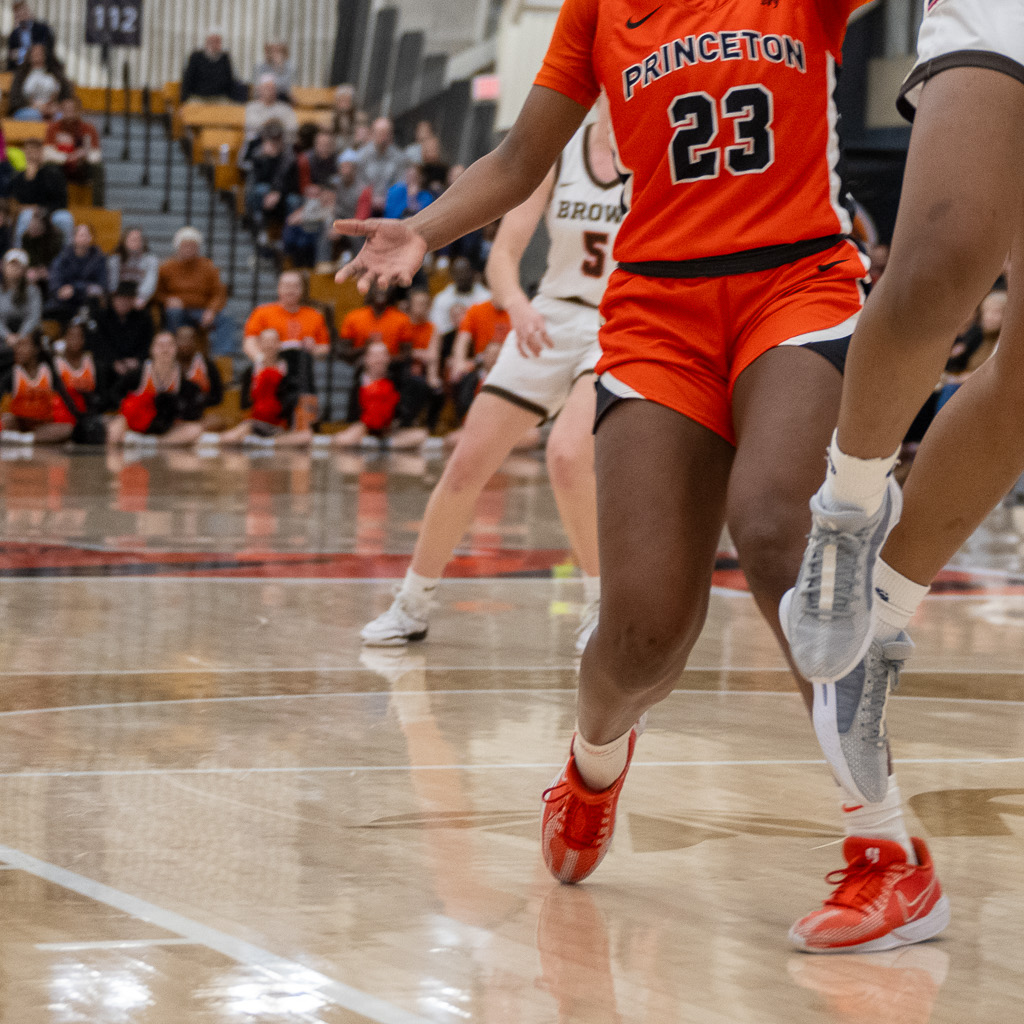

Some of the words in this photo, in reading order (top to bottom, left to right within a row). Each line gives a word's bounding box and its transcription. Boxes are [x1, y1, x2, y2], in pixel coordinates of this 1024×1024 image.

[94, 5, 138, 33] 112
[622, 29, 807, 102] PRINCETON
[667, 83, 775, 186] 23
[557, 200, 623, 224] BROW
[580, 230, 609, 279] 5
